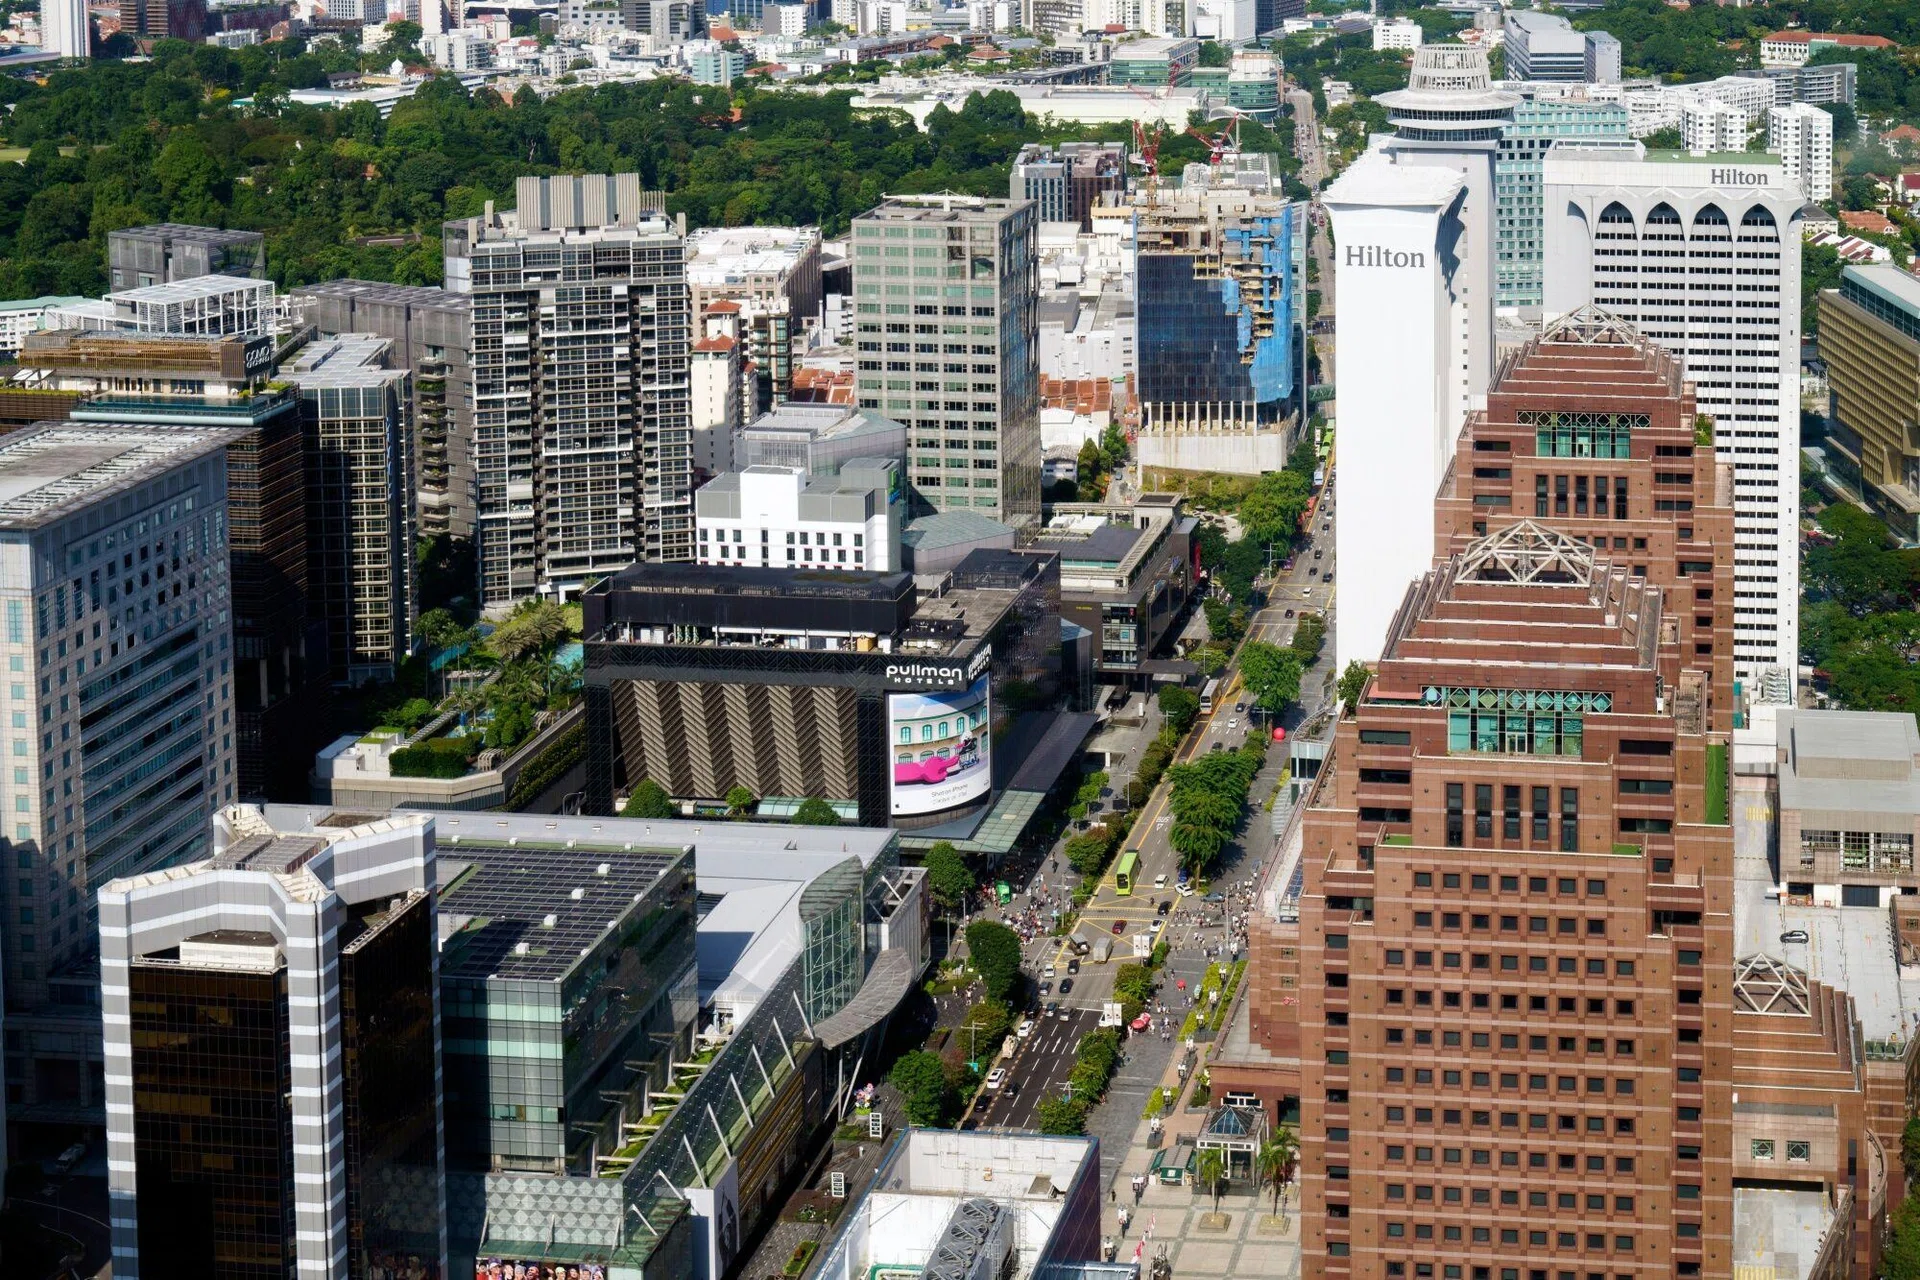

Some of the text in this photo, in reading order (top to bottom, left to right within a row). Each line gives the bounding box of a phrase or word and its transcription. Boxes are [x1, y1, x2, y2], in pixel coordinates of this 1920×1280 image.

[1711, 168, 1769, 185] Hilton
[1345, 245, 1425, 268] Hilton
[246, 346, 270, 361] COMO
[886, 664, 963, 682] pullman
[894, 677, 955, 685] HOTELS
